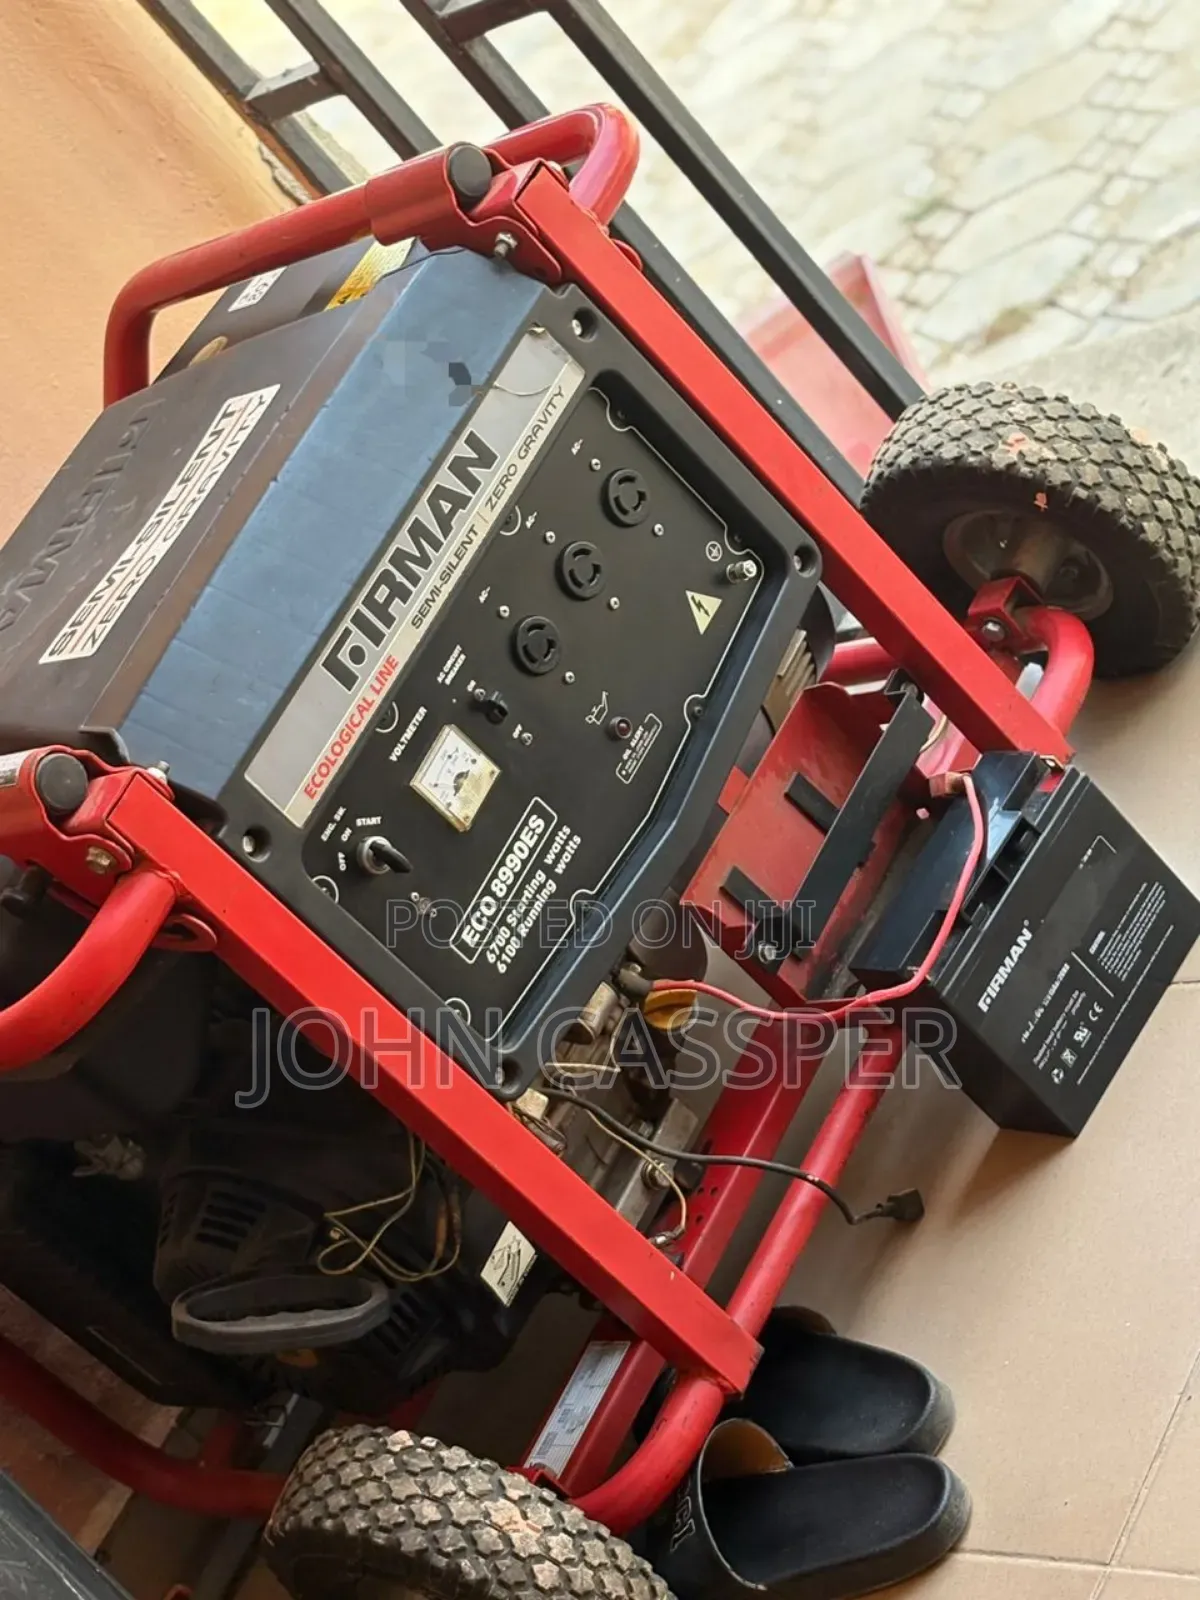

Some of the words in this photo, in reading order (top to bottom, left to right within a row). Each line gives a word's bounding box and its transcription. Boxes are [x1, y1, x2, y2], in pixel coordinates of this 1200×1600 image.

[48, 404, 235, 657] SEMI-SILENT
[81, 555, 156, 652] ZERO
[163, 394, 267, 542] GRAVITY
[411, 523, 479, 630] SEMI-SILENT
[484, 463, 518, 512] ZERO
[517, 385, 565, 461] GRAVITY
[321, 429, 499, 692] FIRMAN
[443, 644, 462, 673] CIRCUIT
[444, 653, 466, 685] BREAKER
[303, 697, 375, 800] ECOLOGICAL
[369, 654, 400, 695] LINE
[389, 705, 428, 762] VOLTMETER
[622, 748, 632, 760] OIL
[630, 725, 644, 748] ALERT
[338, 851, 347, 871] OFF
[341, 827, 352, 842] ON
[356, 816, 382, 827] START
[461, 895, 498, 948] ECO
[490, 814, 545, 898] 8990ES
[485, 925, 511, 964] 6700
[506, 869, 547, 927] Starting
[543, 824, 571, 865] watts
[496, 935, 521, 974] 6100
[517, 879, 557, 938] Running
[554, 834, 582, 875] watts
[977, 928, 1033, 1013] FIRMAN
[1088, 1001, 1104, 1022] CE
